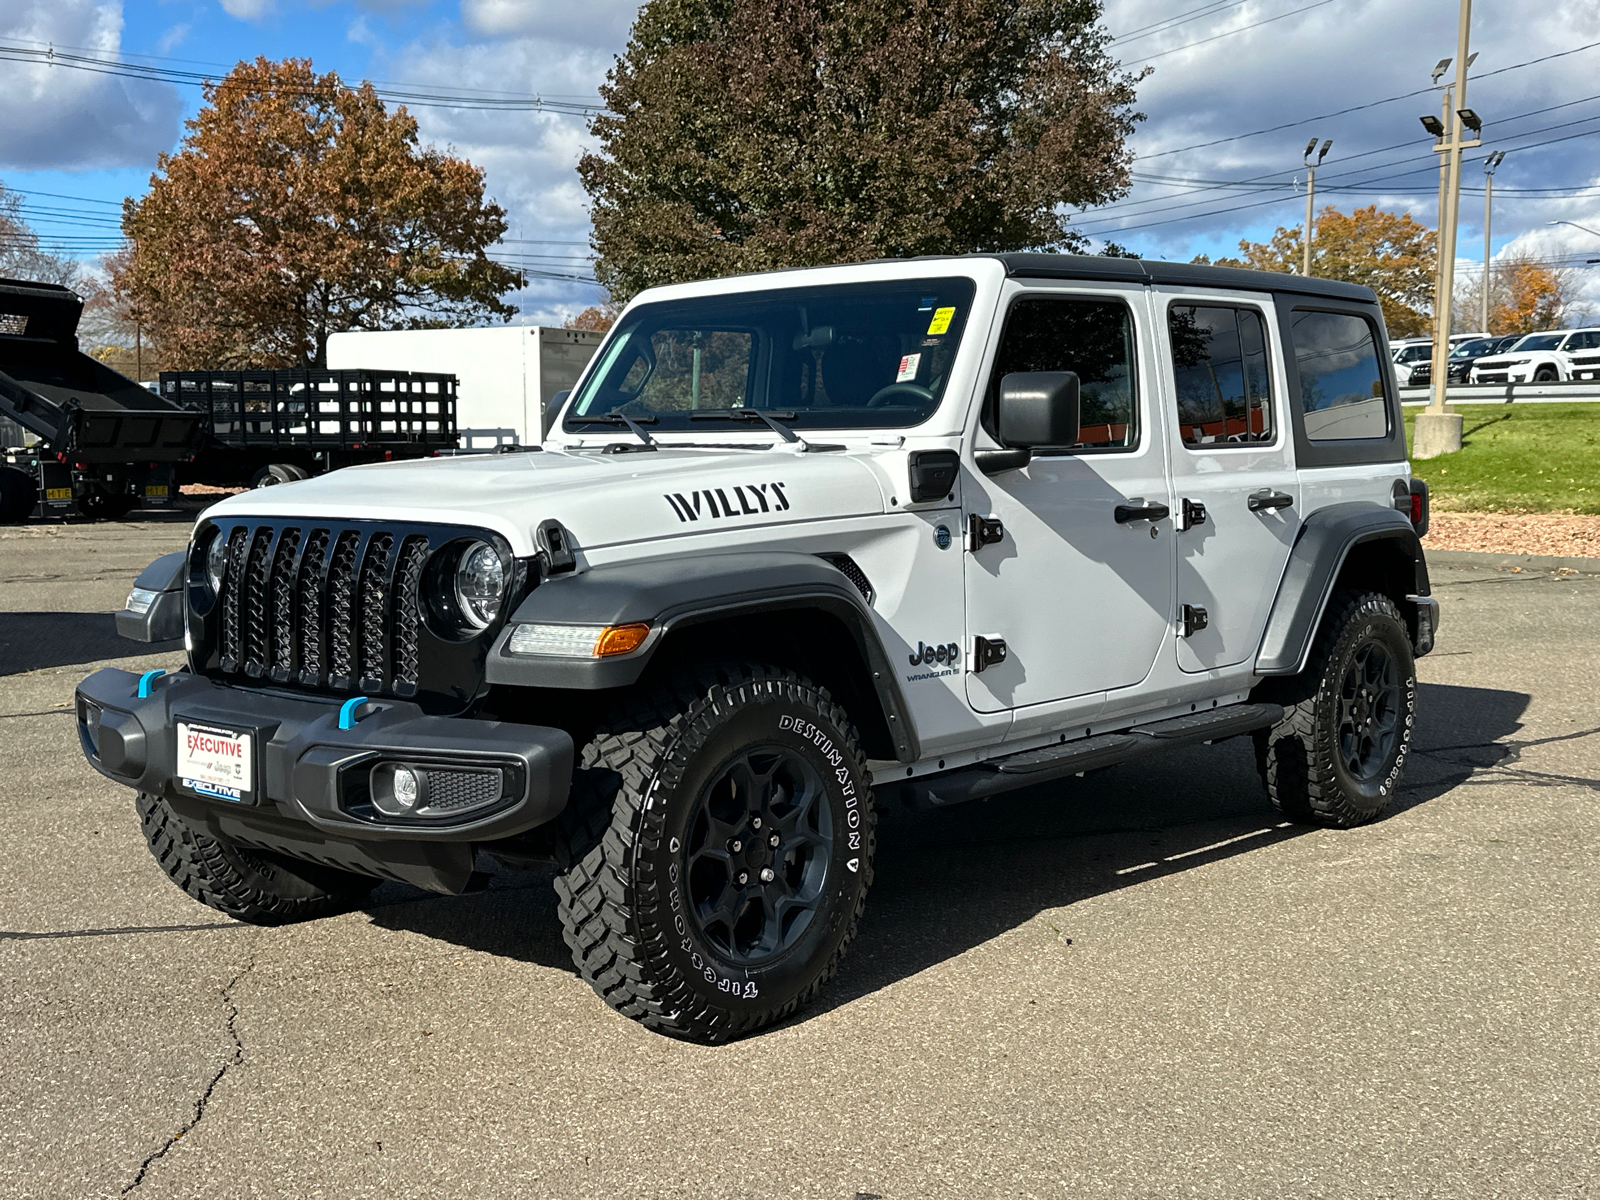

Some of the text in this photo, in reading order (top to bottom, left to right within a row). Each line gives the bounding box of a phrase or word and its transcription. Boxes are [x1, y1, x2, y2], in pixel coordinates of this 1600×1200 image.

[663, 482, 790, 522] WILLYS
[909, 641, 959, 667] Jeep
[906, 669, 952, 683] WRANGLER
[187, 732, 242, 758] EXECUTIVE
[183, 779, 241, 798] EXECUTIVE
[779, 714, 861, 851] DESTINATION
